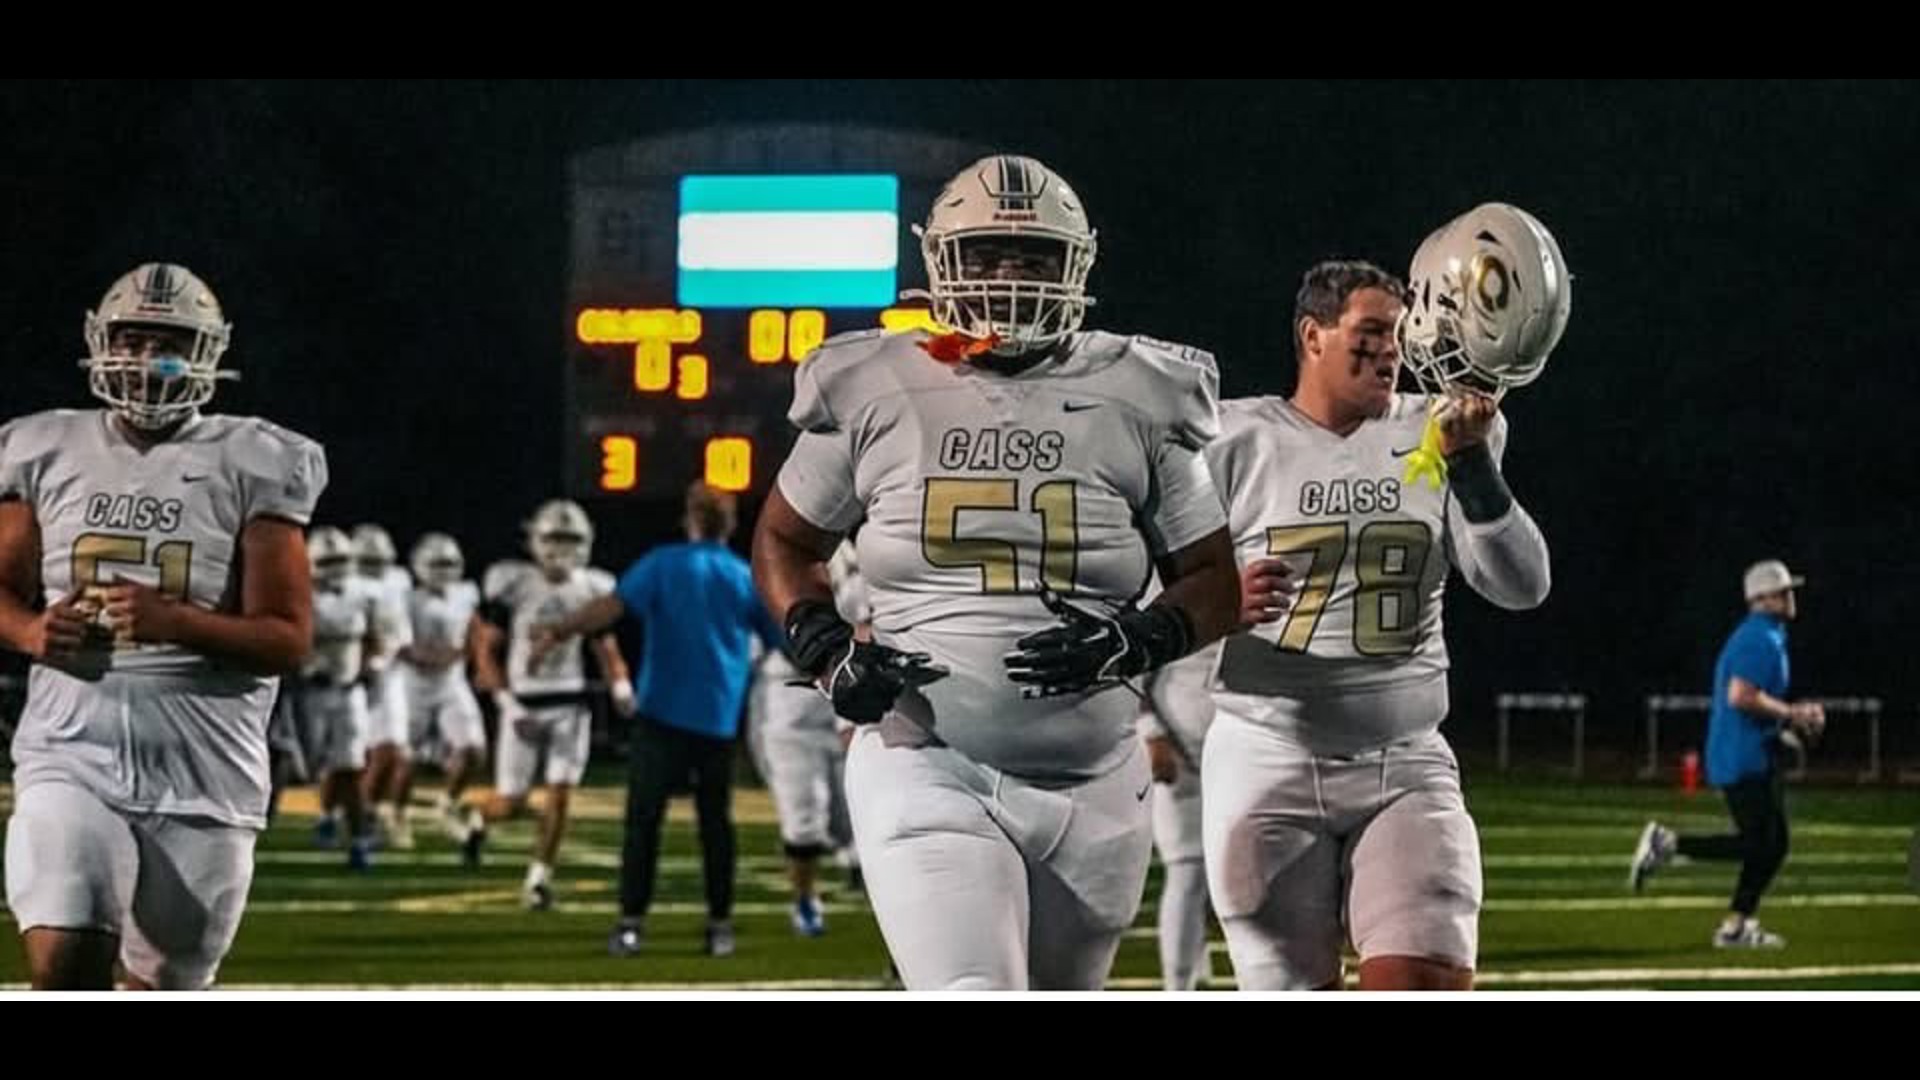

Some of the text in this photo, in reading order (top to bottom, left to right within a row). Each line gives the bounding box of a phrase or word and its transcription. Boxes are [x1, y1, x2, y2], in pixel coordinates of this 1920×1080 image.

[602, 435, 636, 490] 3
[940, 428, 1065, 471] CASS
[84, 494, 182, 531] CASS
[1300, 477, 1401, 516] CASS
[921, 476, 1079, 595] 51
[1266, 520, 1432, 657] 78
